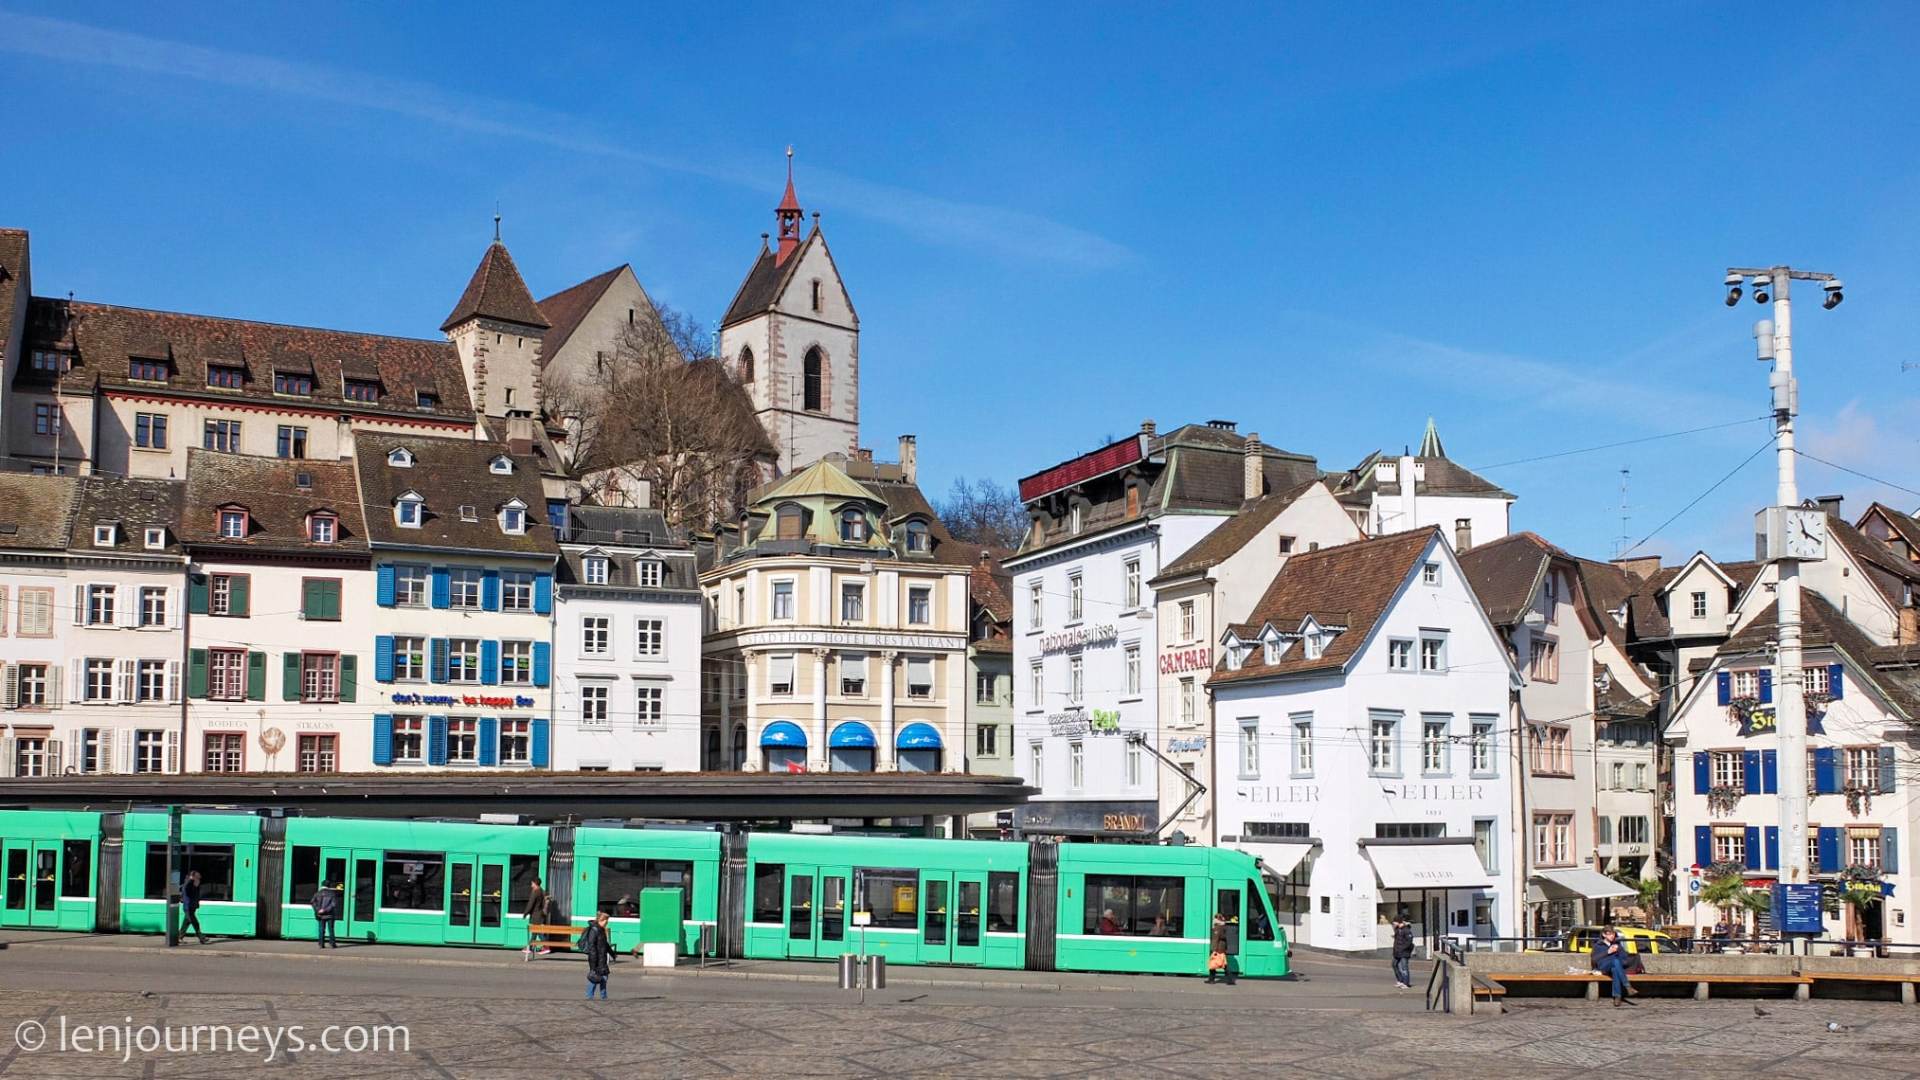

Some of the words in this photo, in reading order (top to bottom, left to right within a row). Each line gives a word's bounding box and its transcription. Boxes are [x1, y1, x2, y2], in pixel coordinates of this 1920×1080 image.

[746, 631, 817, 646] STADTHOF
[824, 633, 866, 645] HOTEL
[875, 635, 964, 649] RESTAURANT
[1160, 648, 1212, 673] CAMPARI
[208, 720, 249, 728] BODEGA
[1237, 786, 1319, 802] SEILER
[1382, 785, 1482, 800] SEILER
